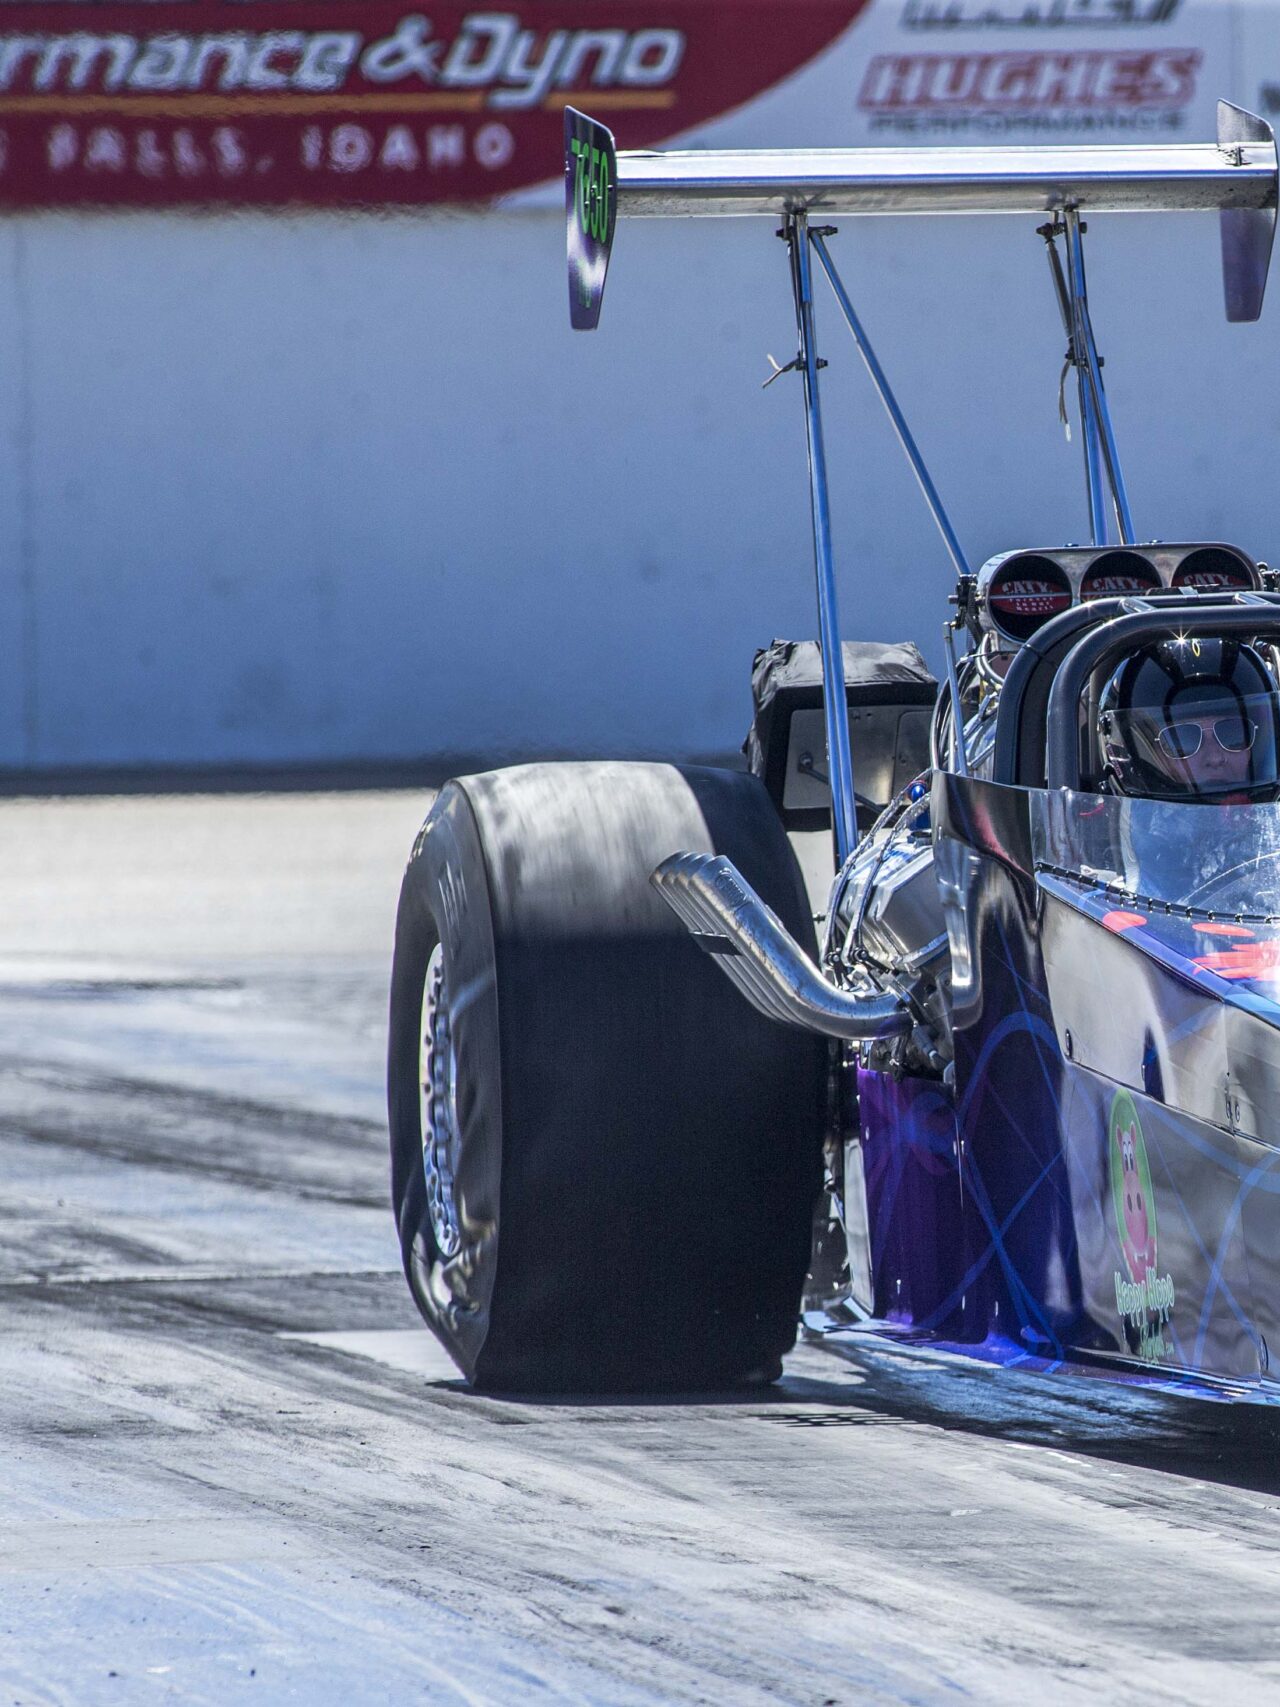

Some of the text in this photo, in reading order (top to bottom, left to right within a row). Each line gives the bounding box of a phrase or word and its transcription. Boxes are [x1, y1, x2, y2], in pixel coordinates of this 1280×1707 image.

[437, 11, 686, 110] Dyno
[856, 48, 1204, 112] HUGHES
[302, 121, 515, 174] IDAHO
